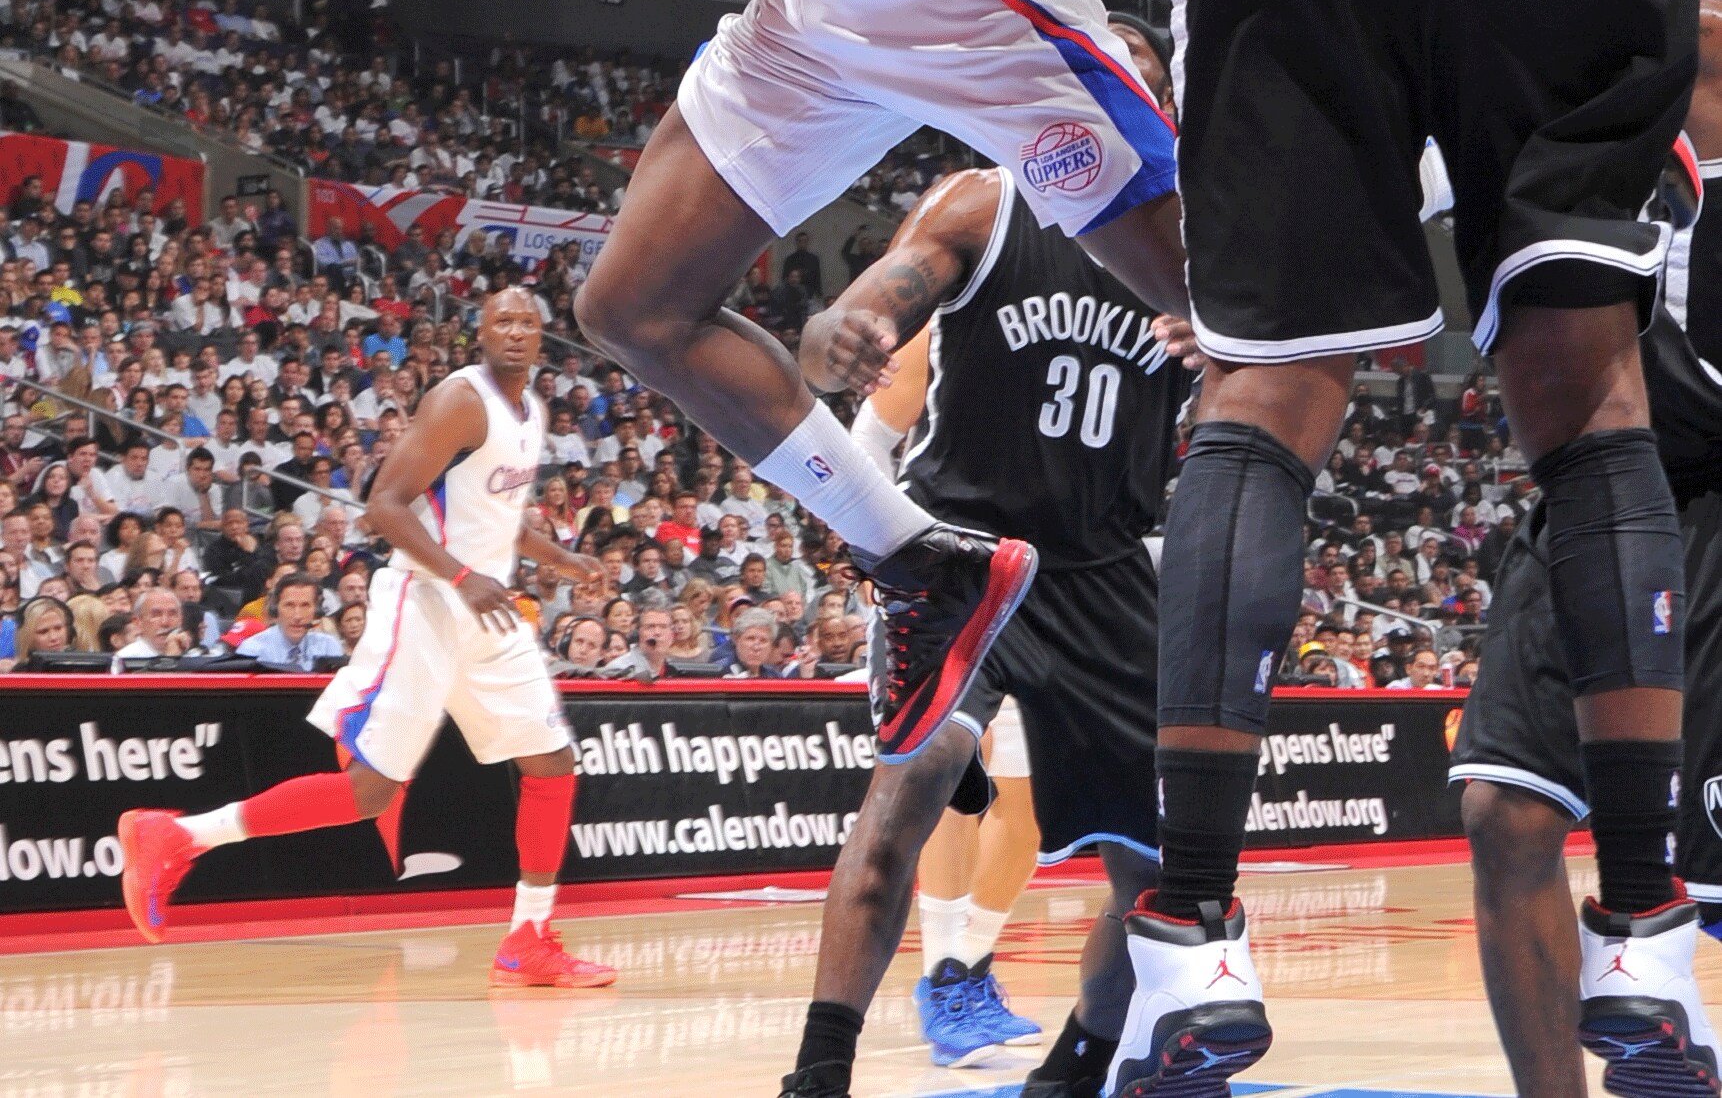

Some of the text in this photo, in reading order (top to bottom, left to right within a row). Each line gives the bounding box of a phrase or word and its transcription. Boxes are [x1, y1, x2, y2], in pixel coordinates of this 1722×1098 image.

[1023, 145, 1097, 193] CLIPPERS
[1040, 137, 1091, 165] LOS ANGELES
[523, 231, 556, 250] LOS
[996, 291, 1171, 376] BROOKLYN
[1038, 354, 1122, 449] 30
[661, 721, 830, 785] happens
